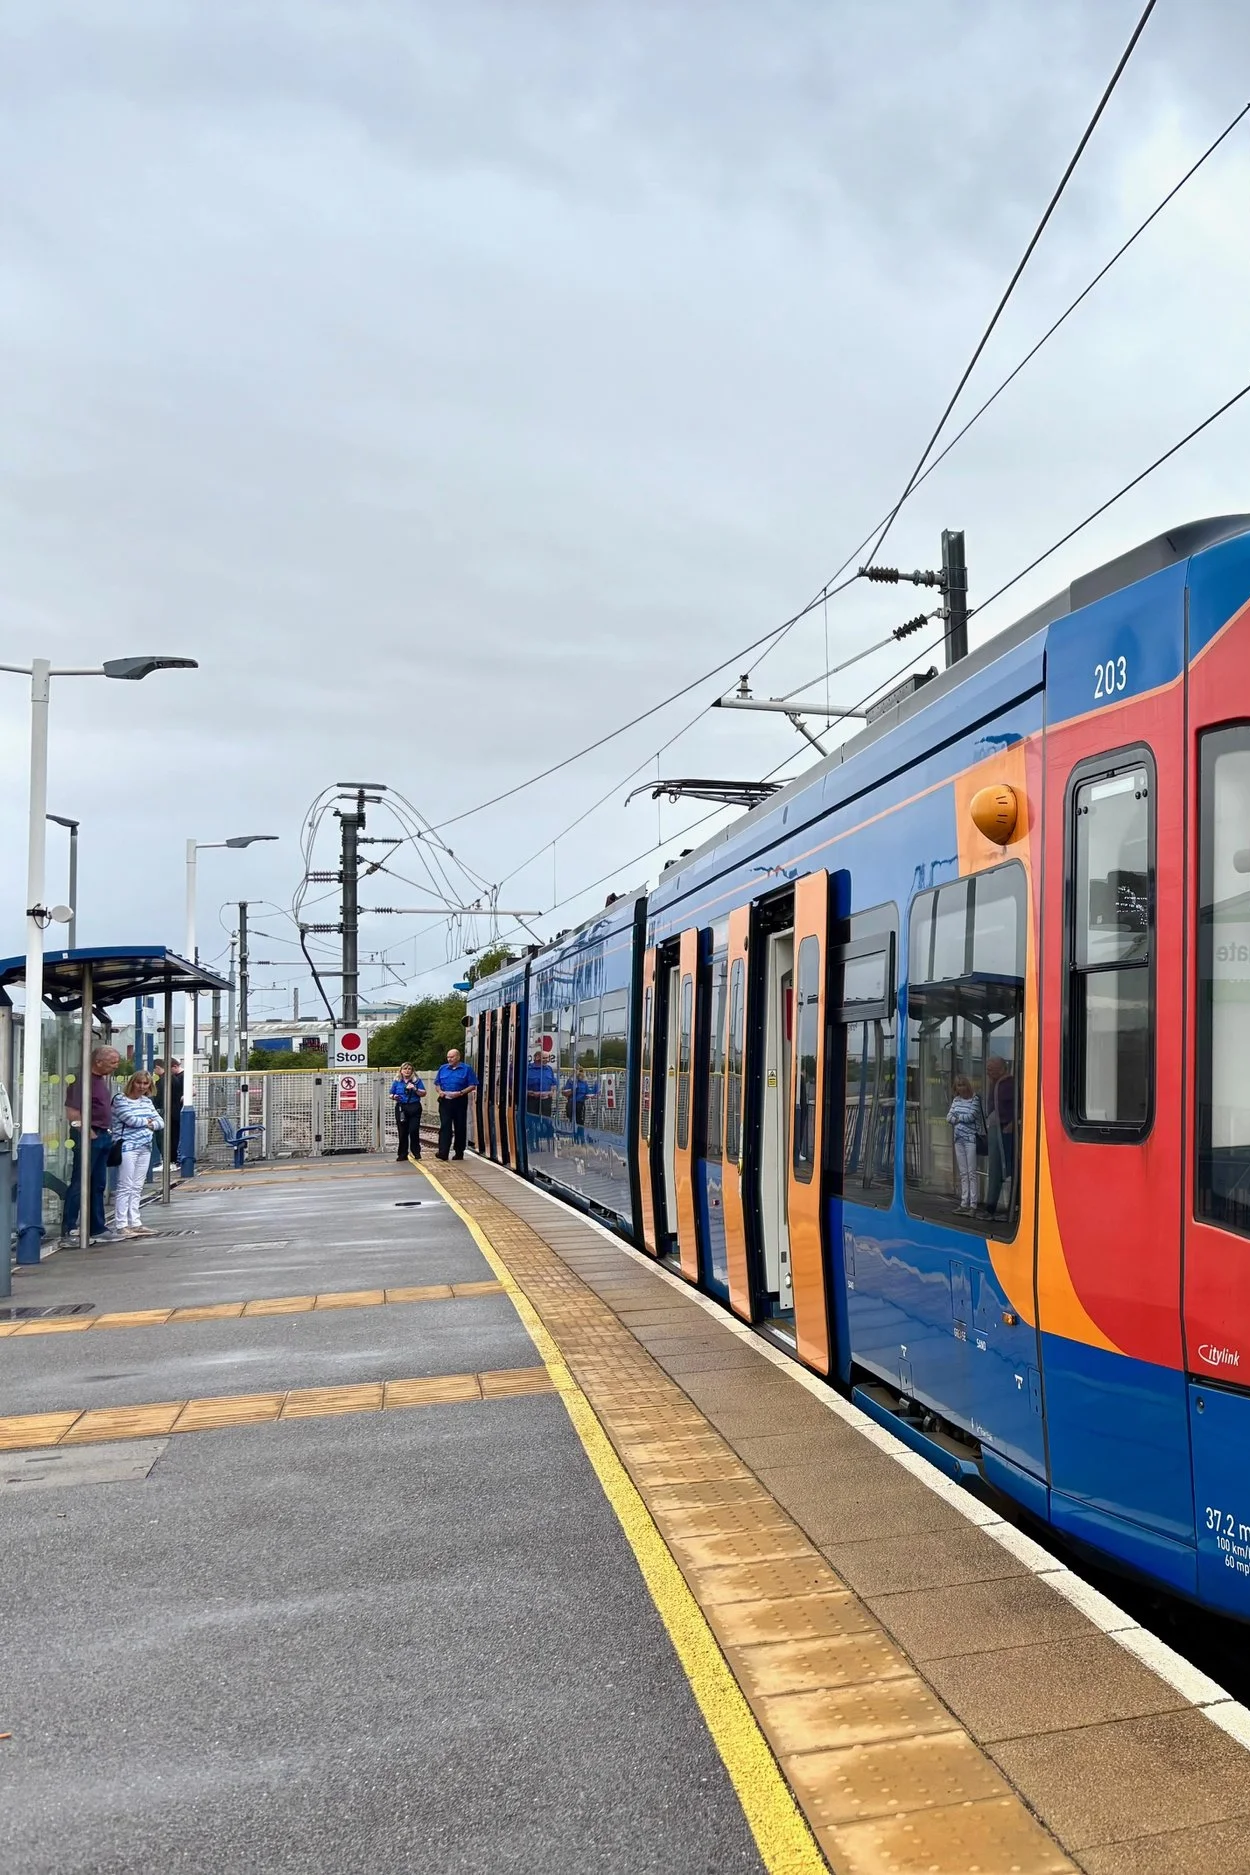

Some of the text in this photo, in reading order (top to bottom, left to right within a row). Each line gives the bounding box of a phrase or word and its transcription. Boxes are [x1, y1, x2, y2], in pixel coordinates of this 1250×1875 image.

[1094, 655, 1127, 699] 203
[336, 1052, 366, 1063] Stop
[1198, 1344, 1240, 1366] Citylink
[1205, 1506, 1235, 1537] 37.2
[1216, 1535, 1231, 1552] 100
[1224, 1554, 1235, 1569] 60
